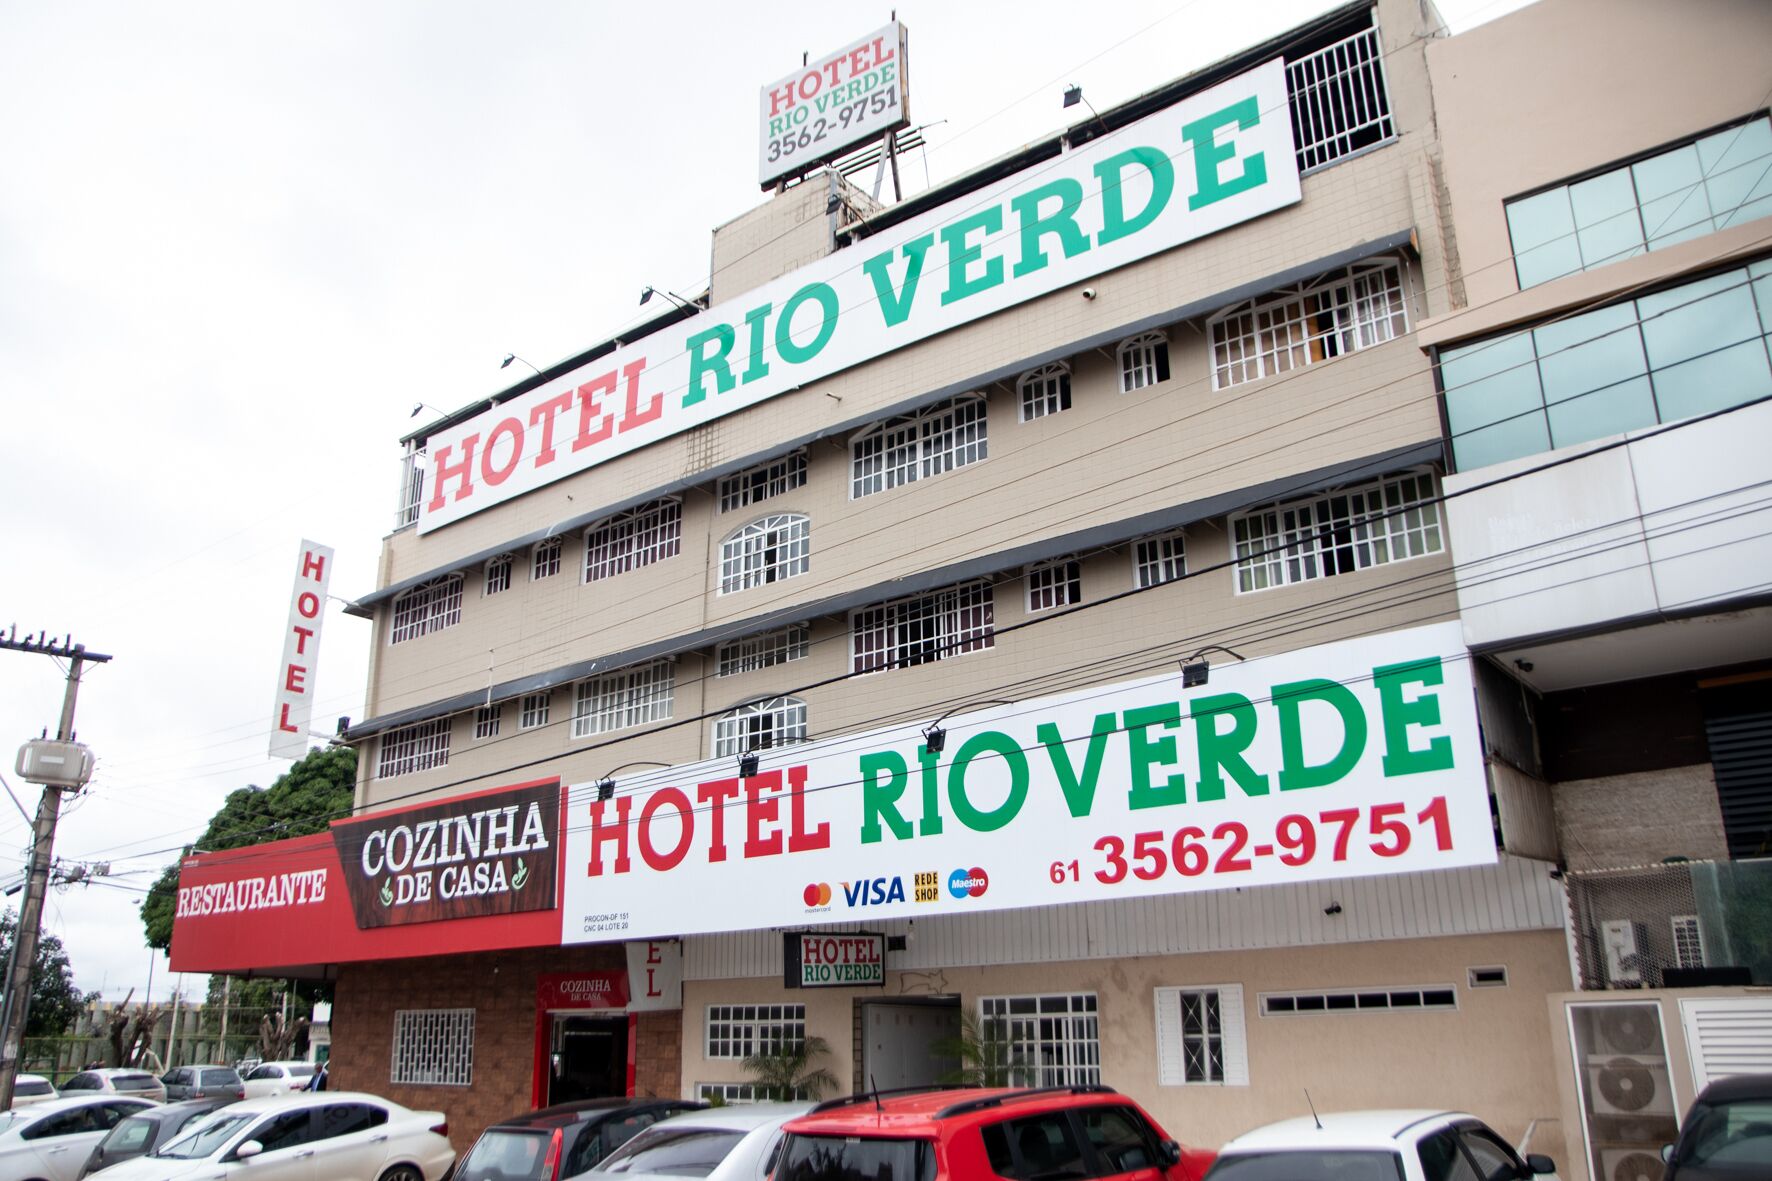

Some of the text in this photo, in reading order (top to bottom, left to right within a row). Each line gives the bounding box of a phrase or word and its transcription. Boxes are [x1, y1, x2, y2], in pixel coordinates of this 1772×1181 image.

[769, 36, 895, 118] HOTEL
[769, 62, 895, 139] RIO VERDE
[767, 85, 898, 163] 3562-9751
[428, 95, 1268, 513] HOTEL RIO VERDE
[279, 551, 326, 733] HOTEL
[587, 765, 830, 877] HOTEL
[362, 801, 549, 878] COZINHA
[1049, 796, 1454, 885] 61 3562-9751
[176, 868, 328, 918] RESTAURANTE
[395, 860, 510, 907] DE CASA
[839, 876, 906, 908] VISA
[914, 872, 938, 886] REDE
[915, 887, 939, 902] SHOP
[951, 876, 986, 889] Maestro
[584, 912, 629, 923] PROCON-DF 151
[804, 906, 832, 914] mastercard
[604, 922, 620, 931] LOTE
[803, 938, 880, 964] HOTEL
[560, 979, 612, 993] COZINHA
[803, 964, 880, 982] RIO VERDE
[571, 992, 603, 1001] DE CASA
